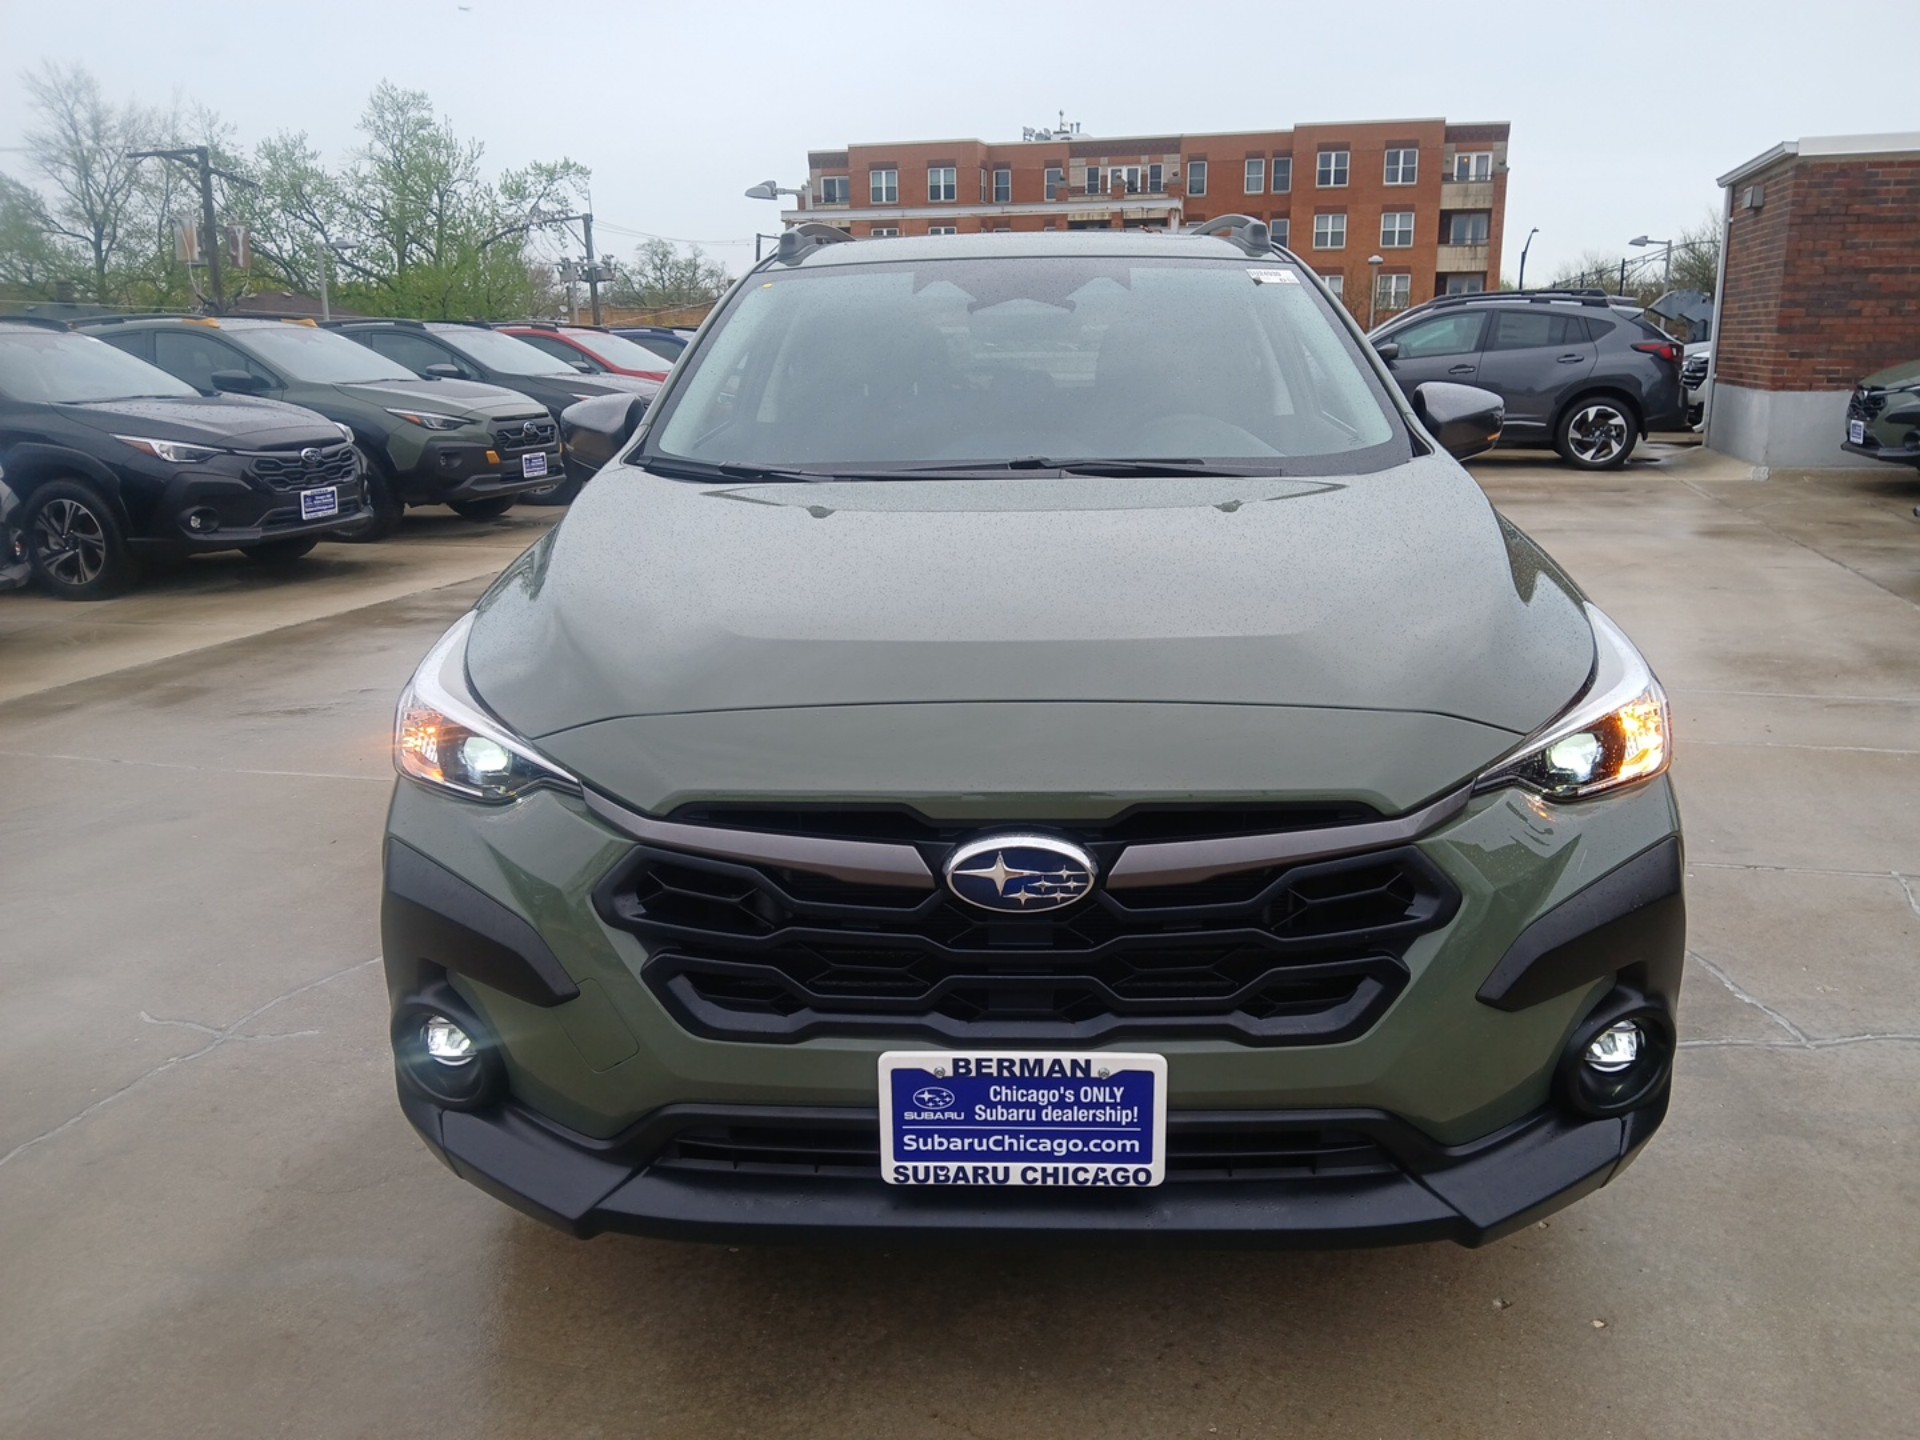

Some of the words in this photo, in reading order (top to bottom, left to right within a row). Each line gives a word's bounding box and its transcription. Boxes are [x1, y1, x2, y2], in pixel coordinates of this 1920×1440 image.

[952, 1058, 1091, 1078] BERMAN
[989, 1086, 1074, 1105] Chicago's
[1080, 1087, 1124, 1103] ONLY
[903, 1111, 964, 1121] SUBARU
[974, 1104, 1036, 1122] Subaru
[1041, 1106, 1138, 1125] dealership!
[903, 1134, 1140, 1156] SubaruChicago.com
[893, 1165, 1010, 1185] SUBARU
[1020, 1166, 1152, 1186] CHICAGO
